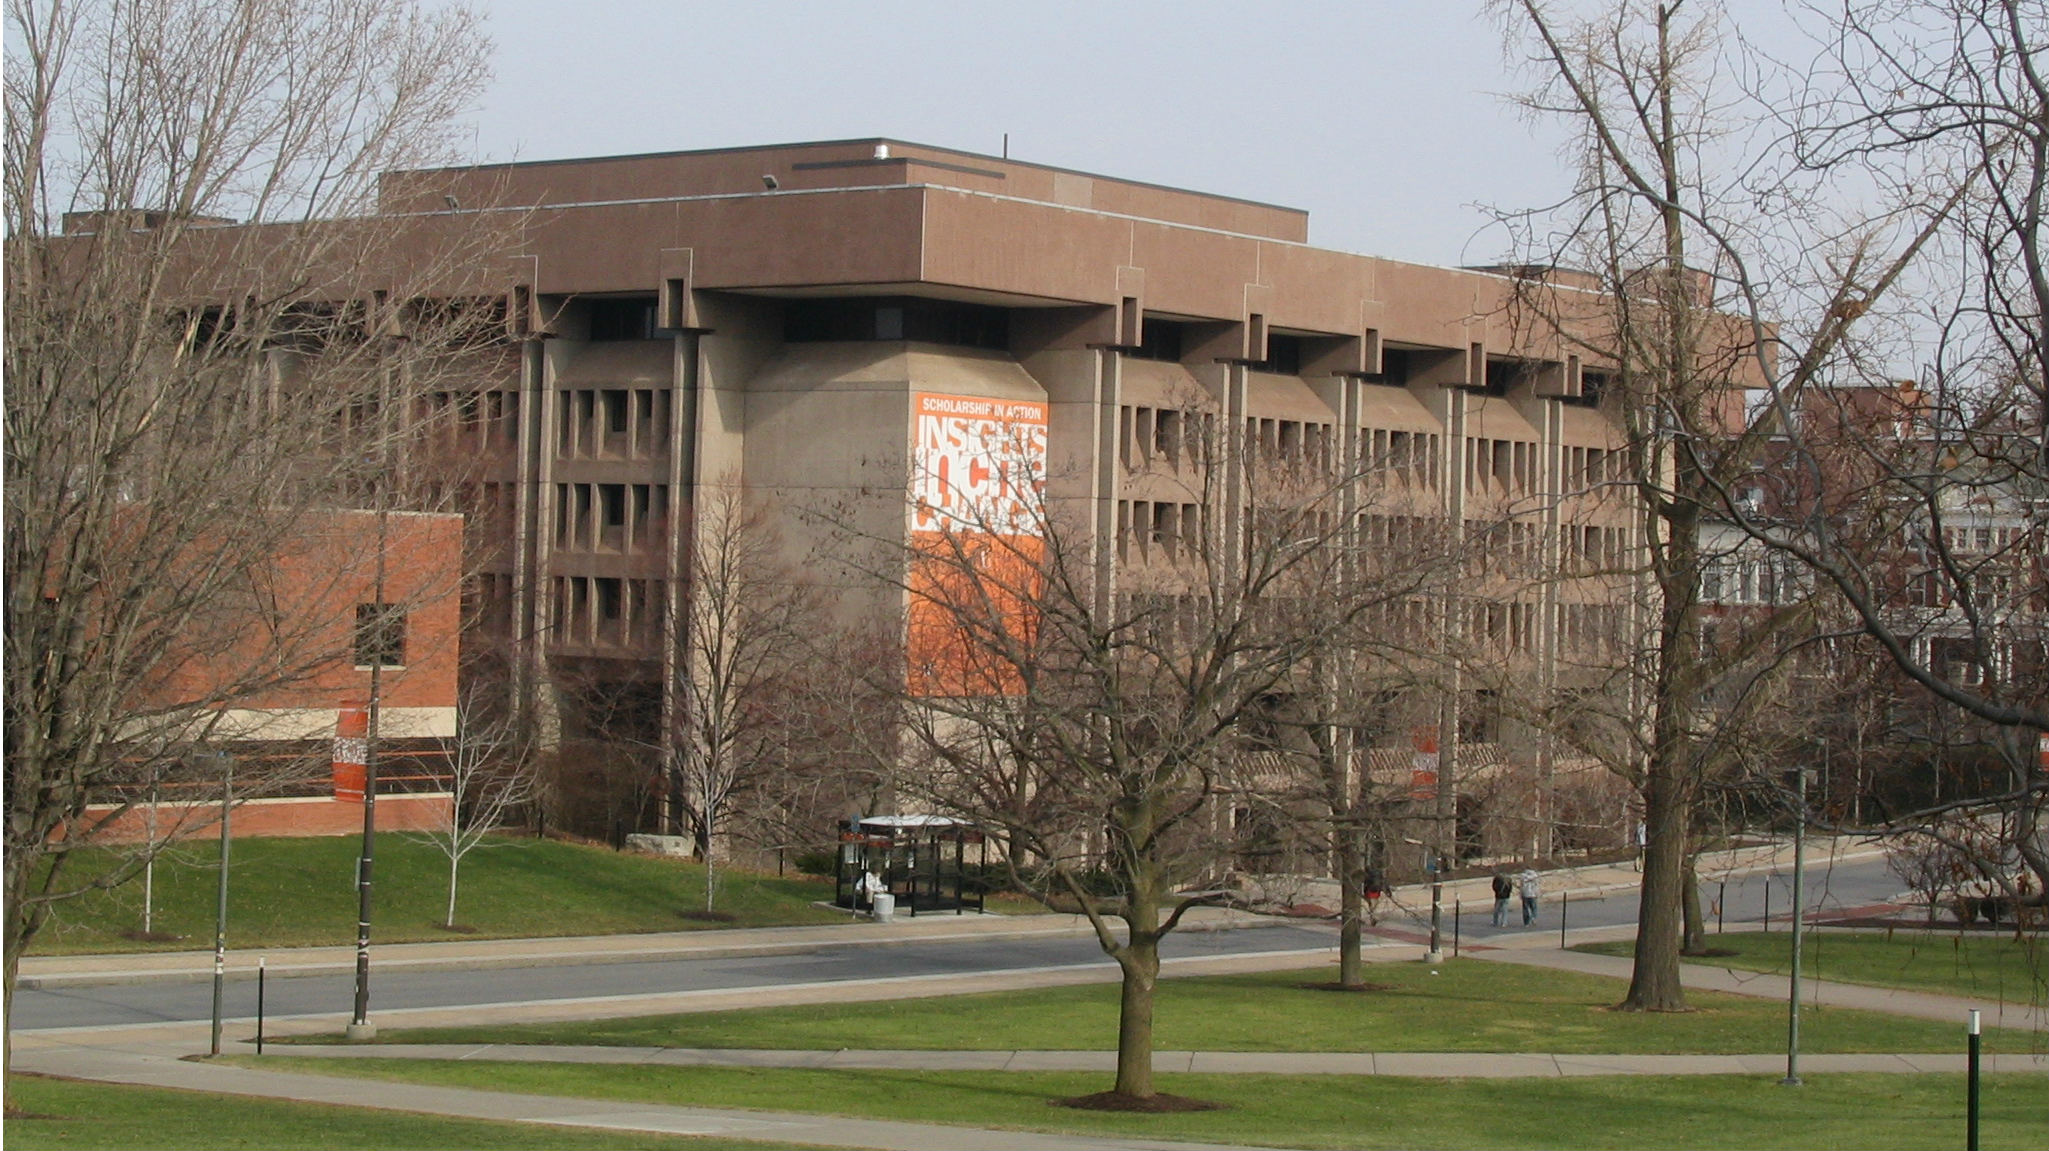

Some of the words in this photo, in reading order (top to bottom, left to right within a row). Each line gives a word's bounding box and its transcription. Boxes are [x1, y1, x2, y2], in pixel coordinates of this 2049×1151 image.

[922, 398, 991, 415] SCHOLARSHIP
[993, 404, 1005, 418] IN
[1006, 406, 1042, 420] ACTION
[918, 414, 1048, 458] INSIGHTS
